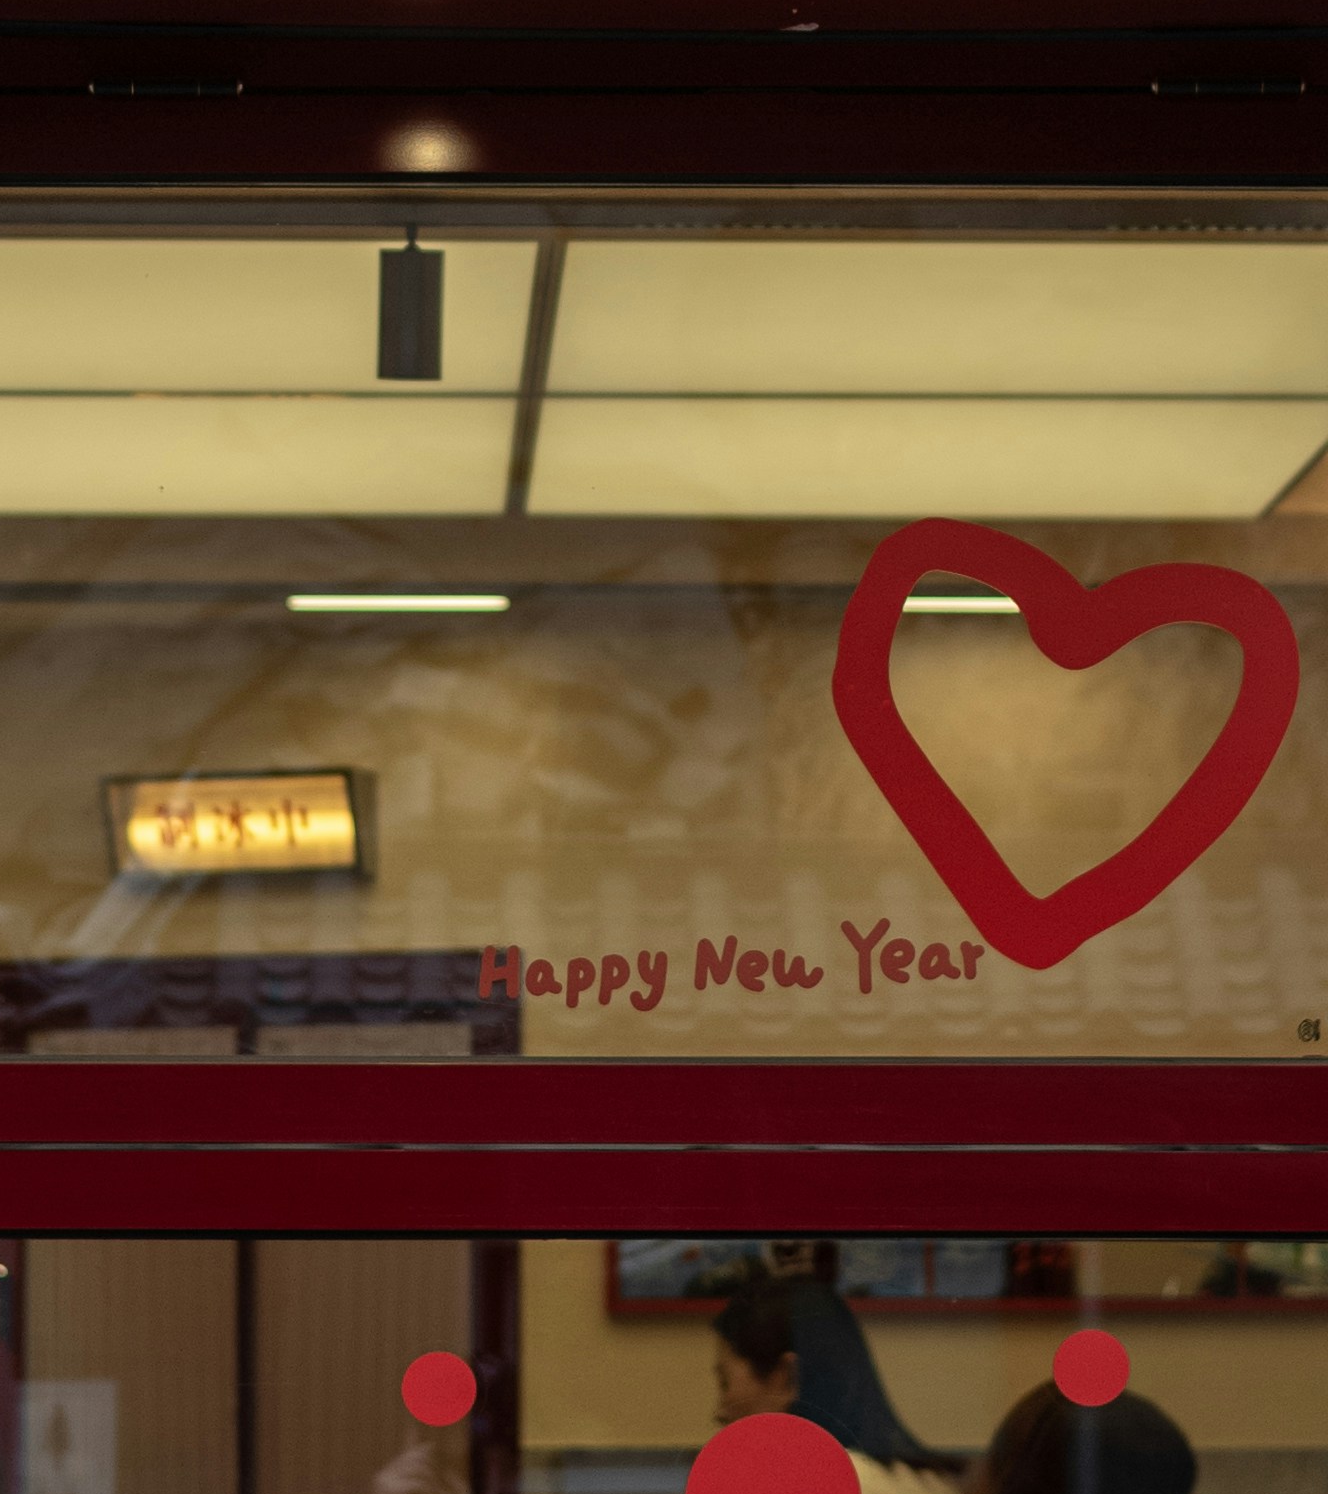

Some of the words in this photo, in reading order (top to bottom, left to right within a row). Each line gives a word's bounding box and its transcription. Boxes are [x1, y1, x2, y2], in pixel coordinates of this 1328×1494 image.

[479, 944, 668, 1012] Happy
[694, 935, 824, 991] New
[840, 917, 985, 995] Year
